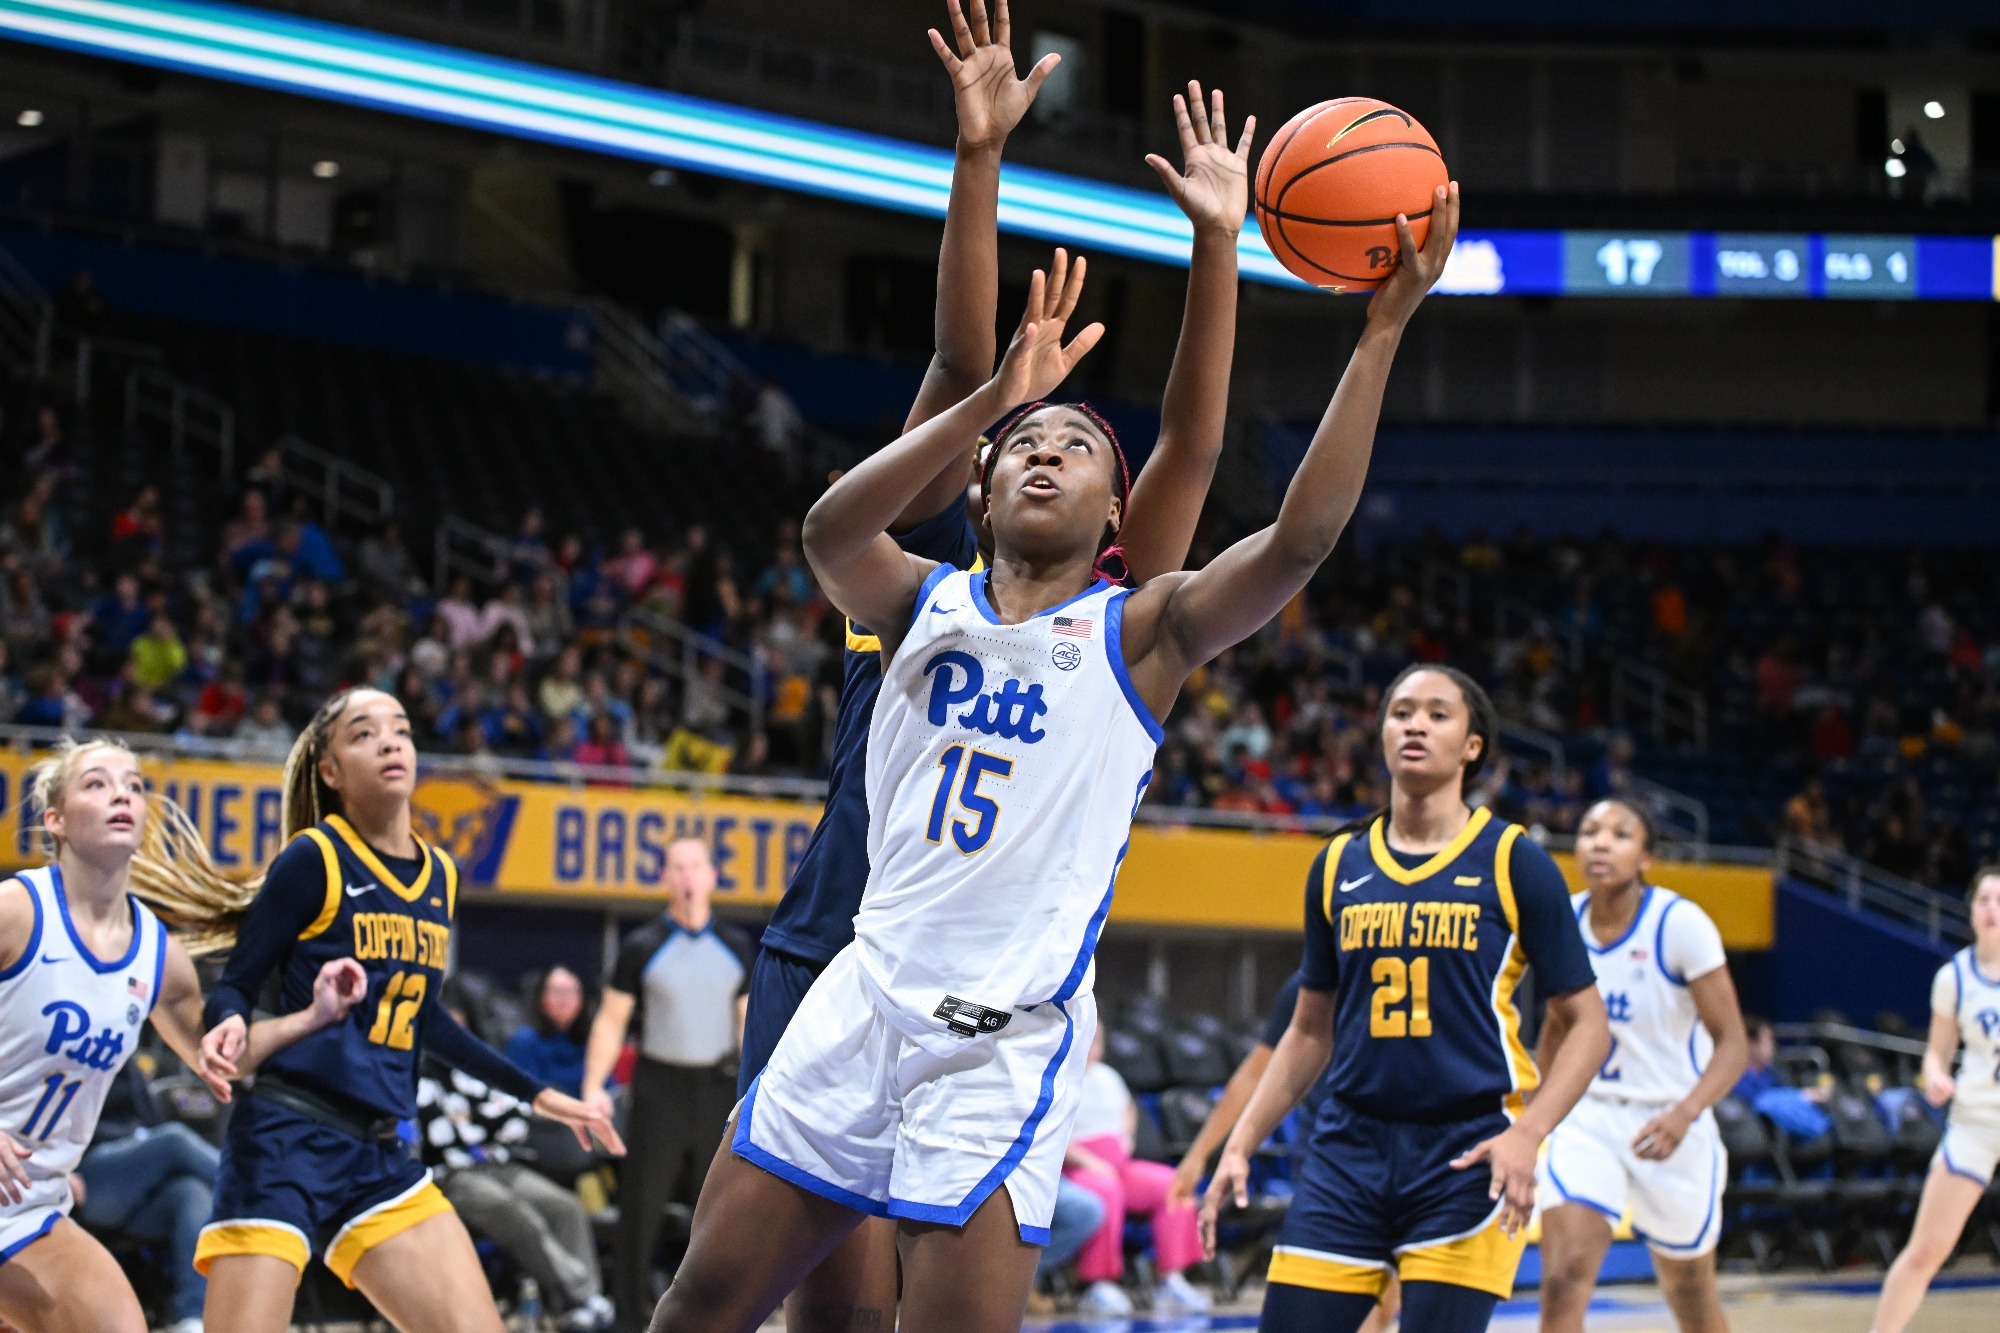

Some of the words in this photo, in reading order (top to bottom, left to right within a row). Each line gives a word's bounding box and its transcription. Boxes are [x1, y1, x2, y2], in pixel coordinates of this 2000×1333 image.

[1365, 246, 1401, 269] Pi
[1597, 239, 1662, 285] 17
[923, 650, 1048, 745] Pitt
[925, 742, 1015, 857] 15
[353, 912, 416, 962] COPPIN
[1340, 902, 1408, 951] COPPIN
[1409, 902, 1481, 951] STATE
[368, 971, 427, 1050] 12
[983, 1016, 998, 1027] 46
[1370, 956, 1432, 1038] 21
[41, 999, 124, 1072] Pitt
[19, 1070, 82, 1142] 11
